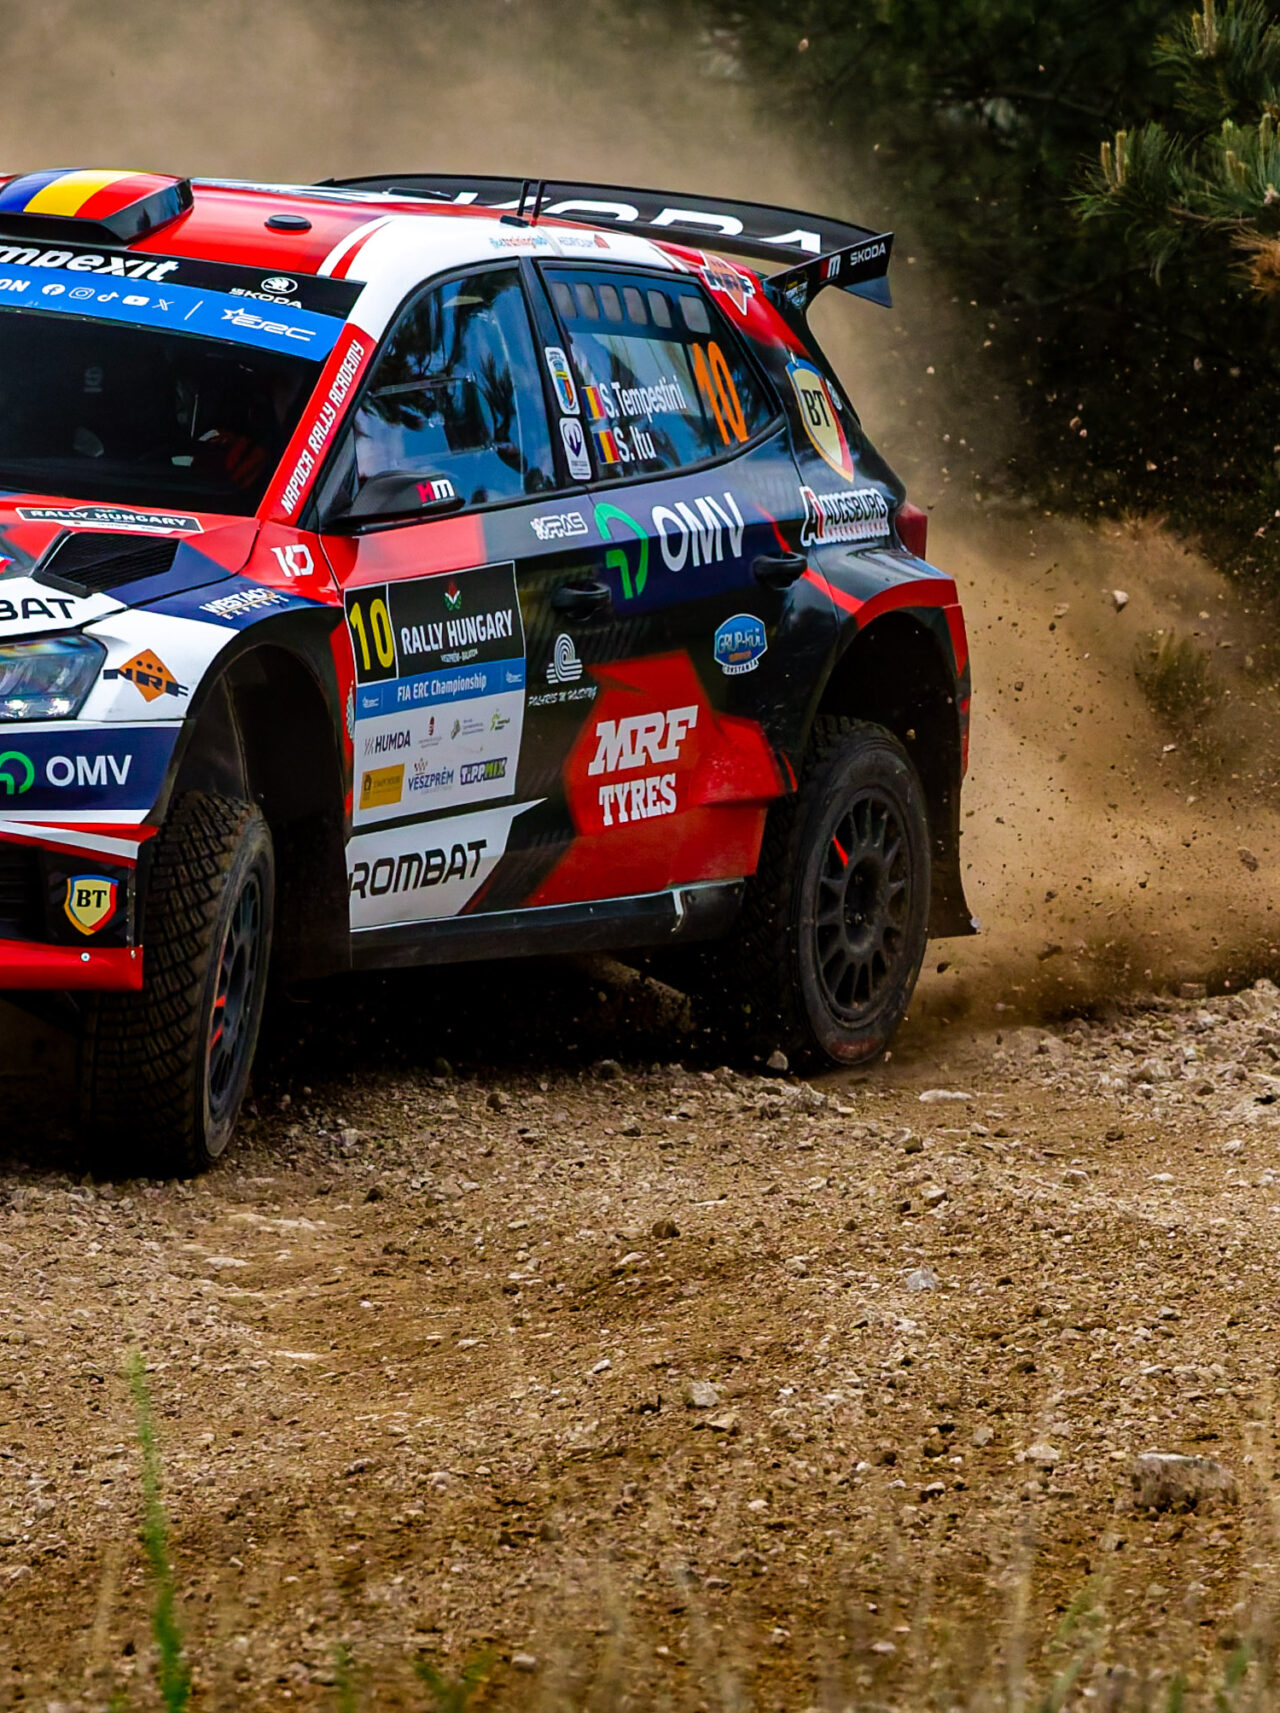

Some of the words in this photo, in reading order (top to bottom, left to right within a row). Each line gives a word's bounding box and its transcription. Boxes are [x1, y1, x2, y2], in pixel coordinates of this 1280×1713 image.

[694, 341, 750, 446] 10
[801, 388, 831, 428] BT
[280, 449, 316, 516] NAPOCA
[308, 401, 338, 455] RALLY
[328, 339, 366, 408] ACADEMY
[30, 510, 87, 520] RALLY
[94, 513, 187, 526] HUNGARY
[824, 491, 888, 526] AUGSBURG
[651, 491, 745, 573] OMV
[349, 598, 394, 671] 10
[400, 621, 444, 656] RALLY
[449, 608, 513, 648] HUNGARY
[102, 668, 189, 698] NRF
[397, 684, 412, 702] FIA
[413, 681, 430, 700] ERC
[431, 673, 487, 697] Championship
[374, 729, 411, 754] HUMDA
[588, 704, 699, 776] MRF
[45, 755, 132, 787] OMV
[408, 766, 454, 791] VESZPRÉM
[599, 773, 677, 826] TYRES
[349, 838, 487, 899] ROMBAT
[75, 889, 108, 909] BT
